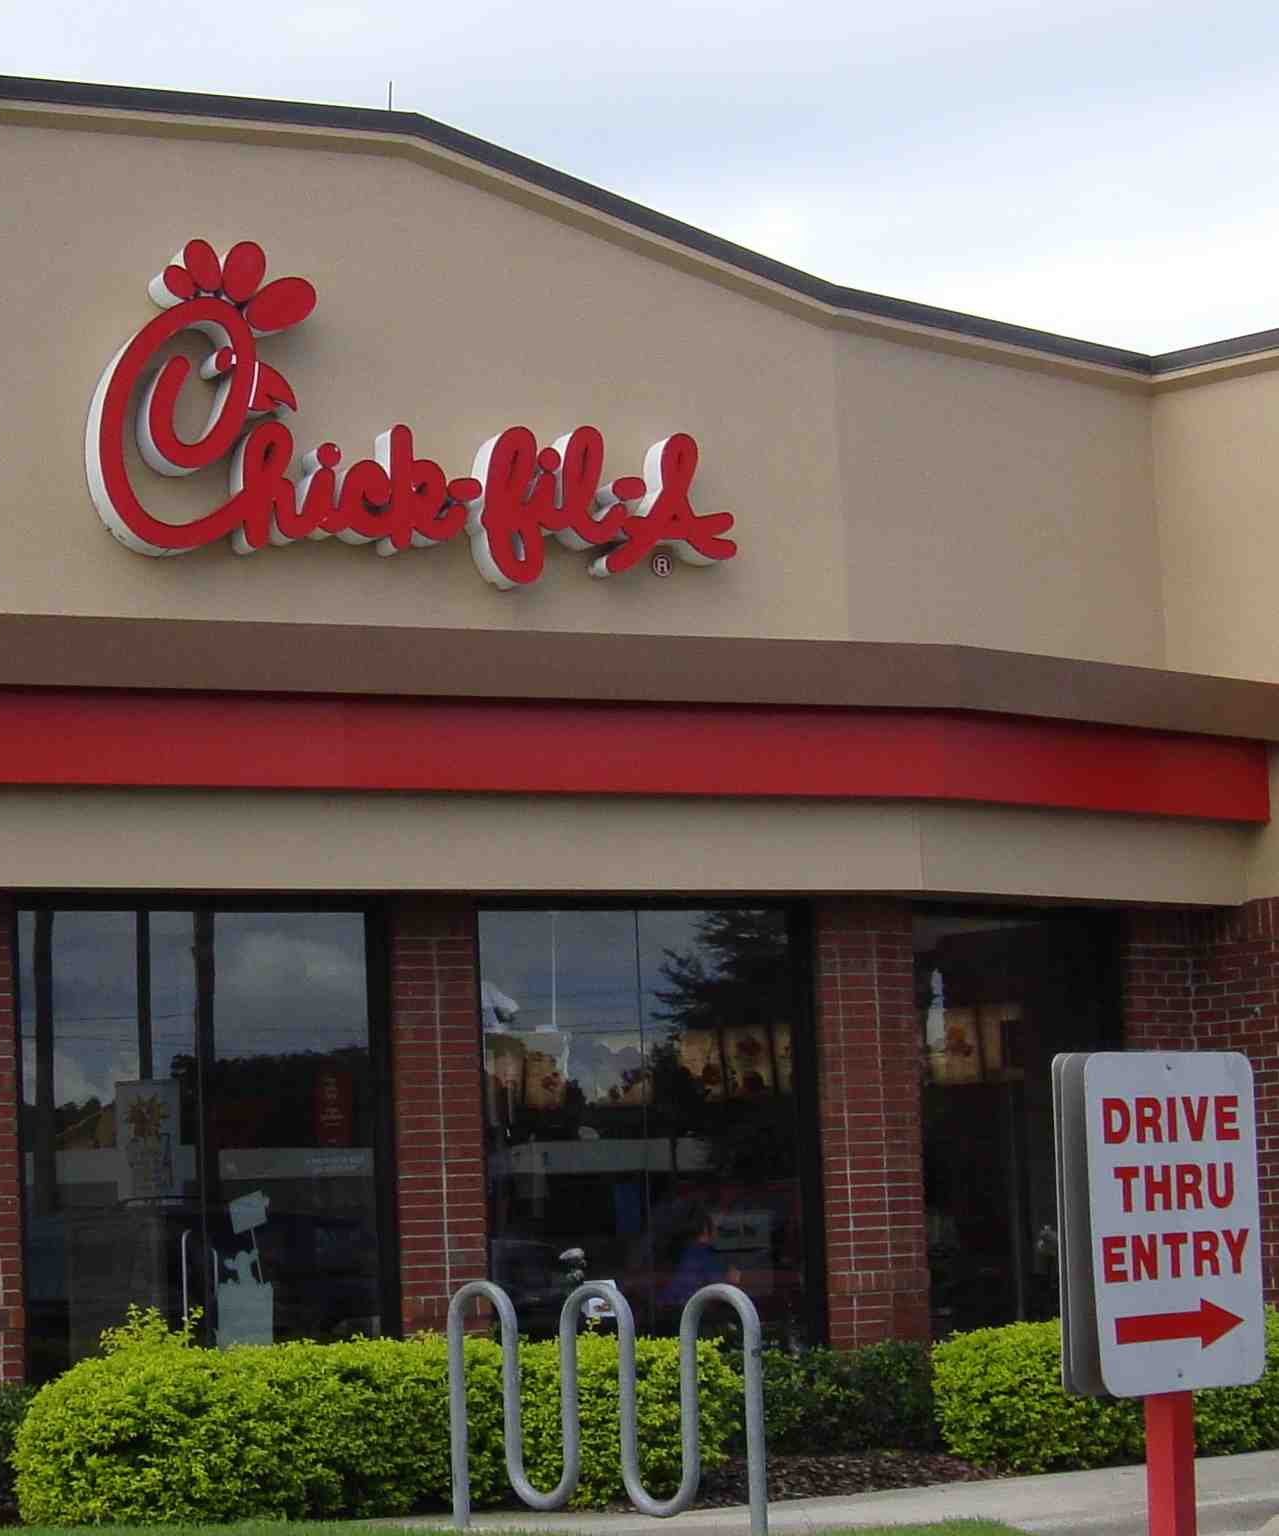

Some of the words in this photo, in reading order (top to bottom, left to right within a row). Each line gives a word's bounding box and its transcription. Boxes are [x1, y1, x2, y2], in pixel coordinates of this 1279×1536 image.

[87, 241, 737, 591] Chick-fil-A
[1102, 1095, 1240, 1144] DRIVE
[1113, 1163, 1234, 1212] THRU
[1102, 1229, 1249, 1283] ENTRY
